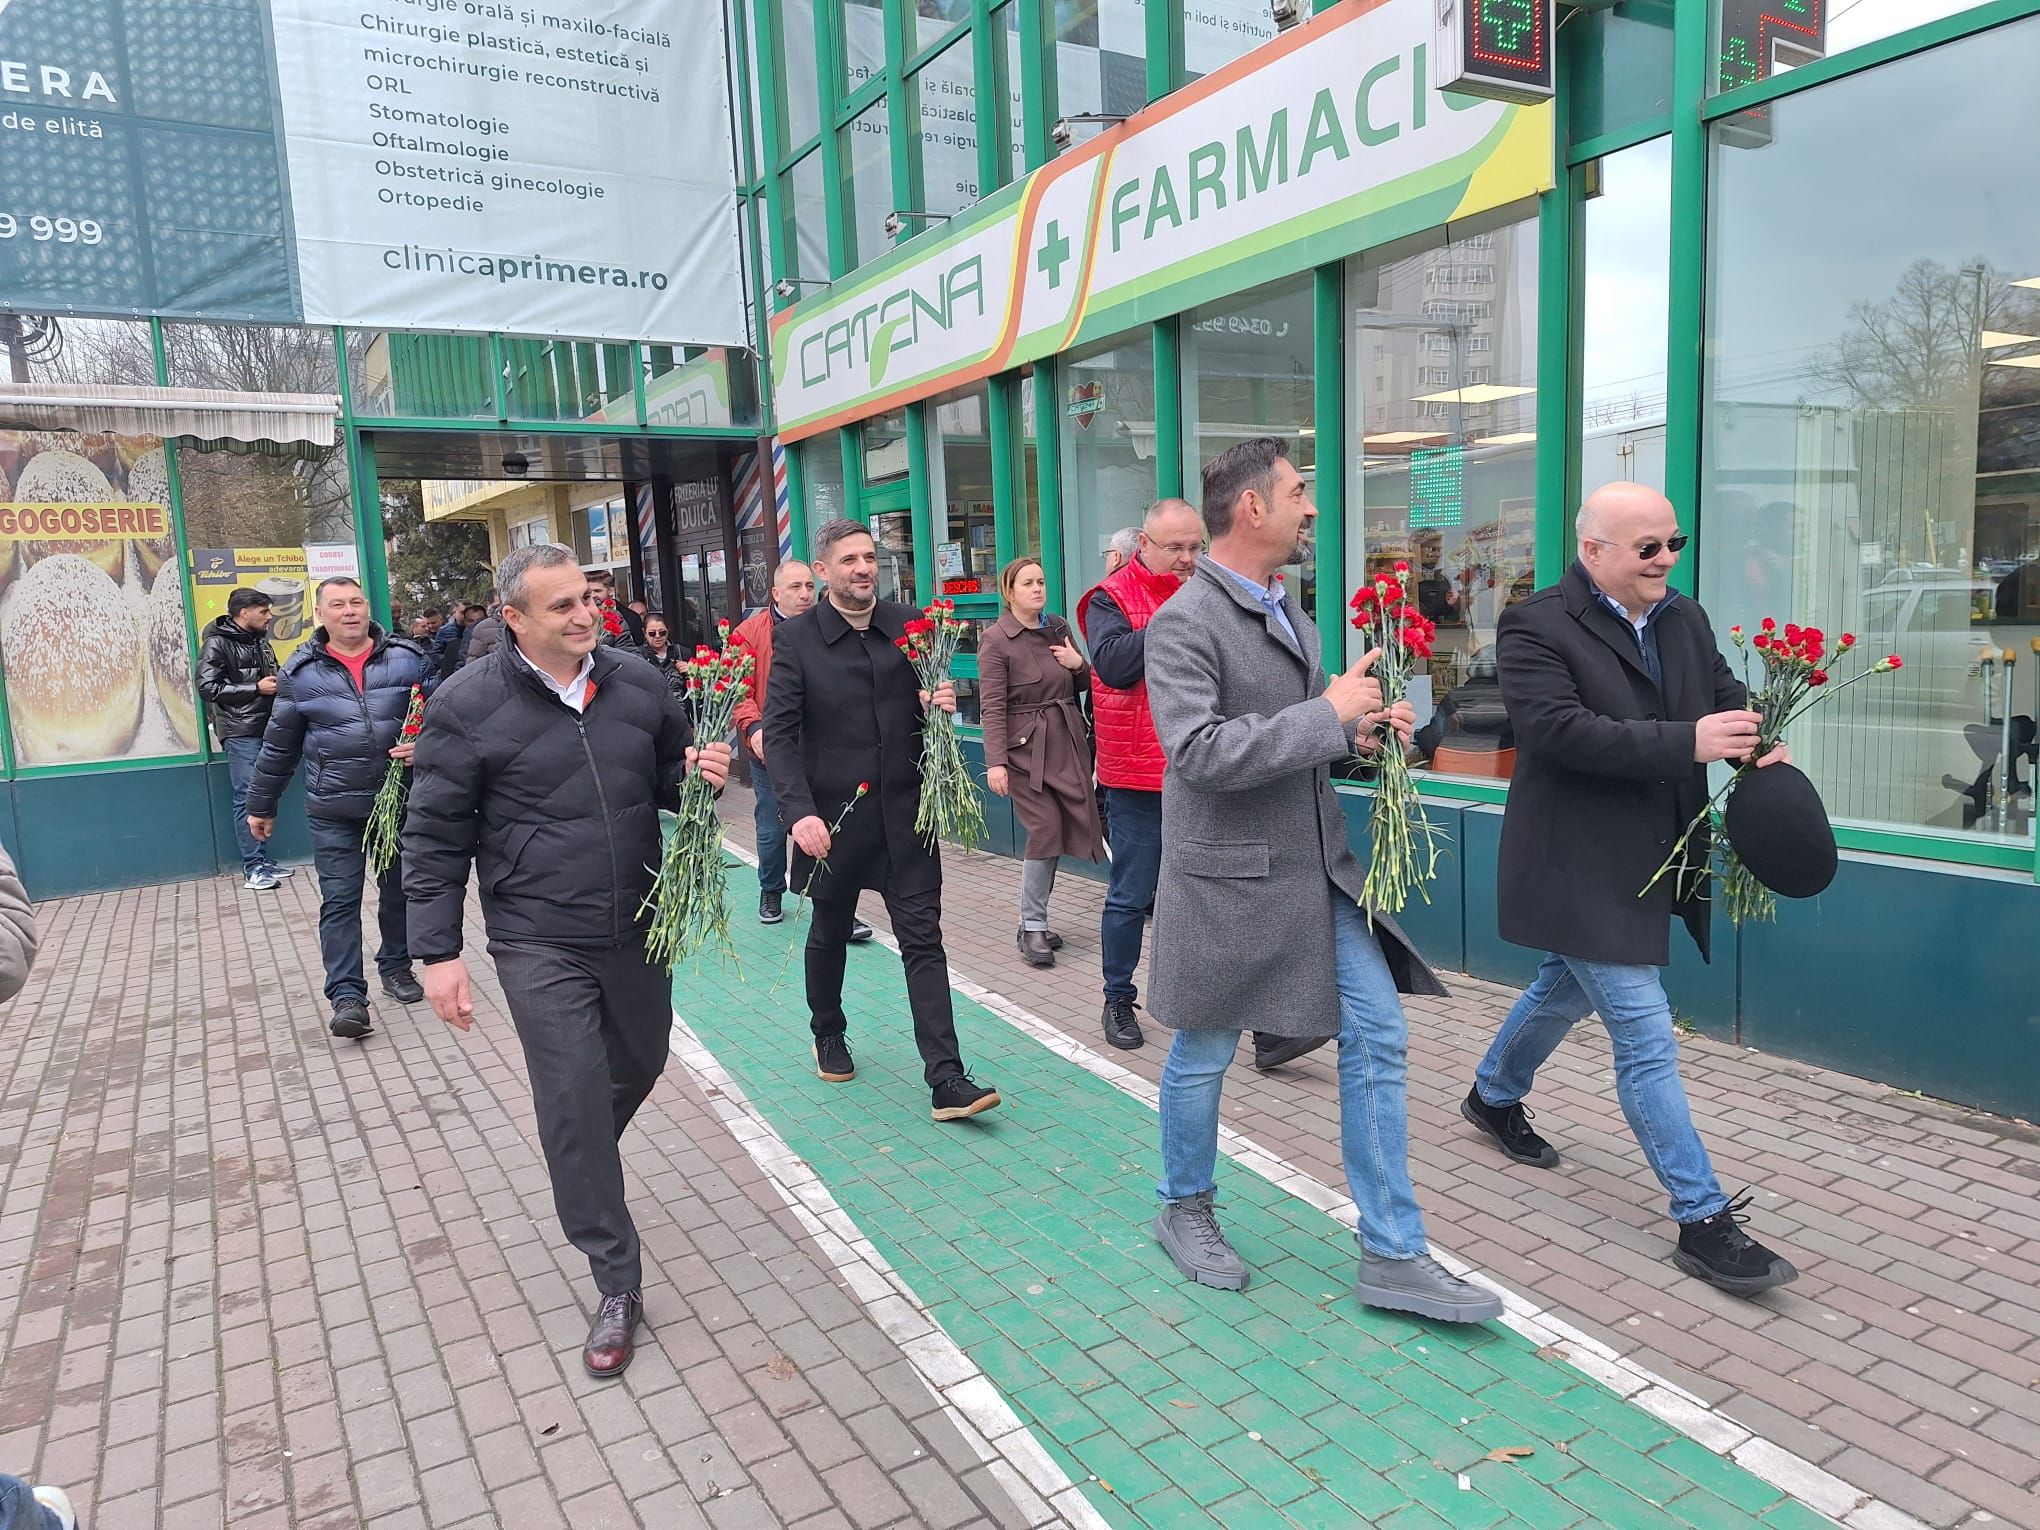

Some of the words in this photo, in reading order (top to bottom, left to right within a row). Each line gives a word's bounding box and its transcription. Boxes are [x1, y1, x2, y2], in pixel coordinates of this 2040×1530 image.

[464, 2, 514, 21] orală
[520, 9, 535, 28] și
[542, 15, 671, 48] maxilo-facială
[360, 13, 461, 43] Chirurgie
[467, 31, 550, 59] plastică,
[555, 46, 630, 69] estetică
[635, 57, 649, 76] și
[1, 60, 117, 103] ERA
[364, 47, 519, 82] microchirurgie
[525, 70, 660, 103] reconstructivă
[366, 74, 412, 94] ORL
[2, 112, 36, 131] de
[45, 116, 104, 138] elită
[369, 103, 510, 135] Stomatologie
[372, 131, 509, 162] Oftalmologie
[1112, 42, 1490, 253] FARMACI
[375, 160, 485, 186] Obstetrică
[491, 172, 605, 200] ginecologie
[378, 188, 484, 212] Ortopedie
[30, 215, 103, 245] 999
[383, 244, 668, 291] clinicaprimera.ro
[801, 254, 984, 389] CATENA
[0, 508, 163, 535] GOGOSERIE
[198, 570, 235, 579] Tchibo
[237, 555, 261, 564] Alege
[276, 554, 304, 563] Tchibo
